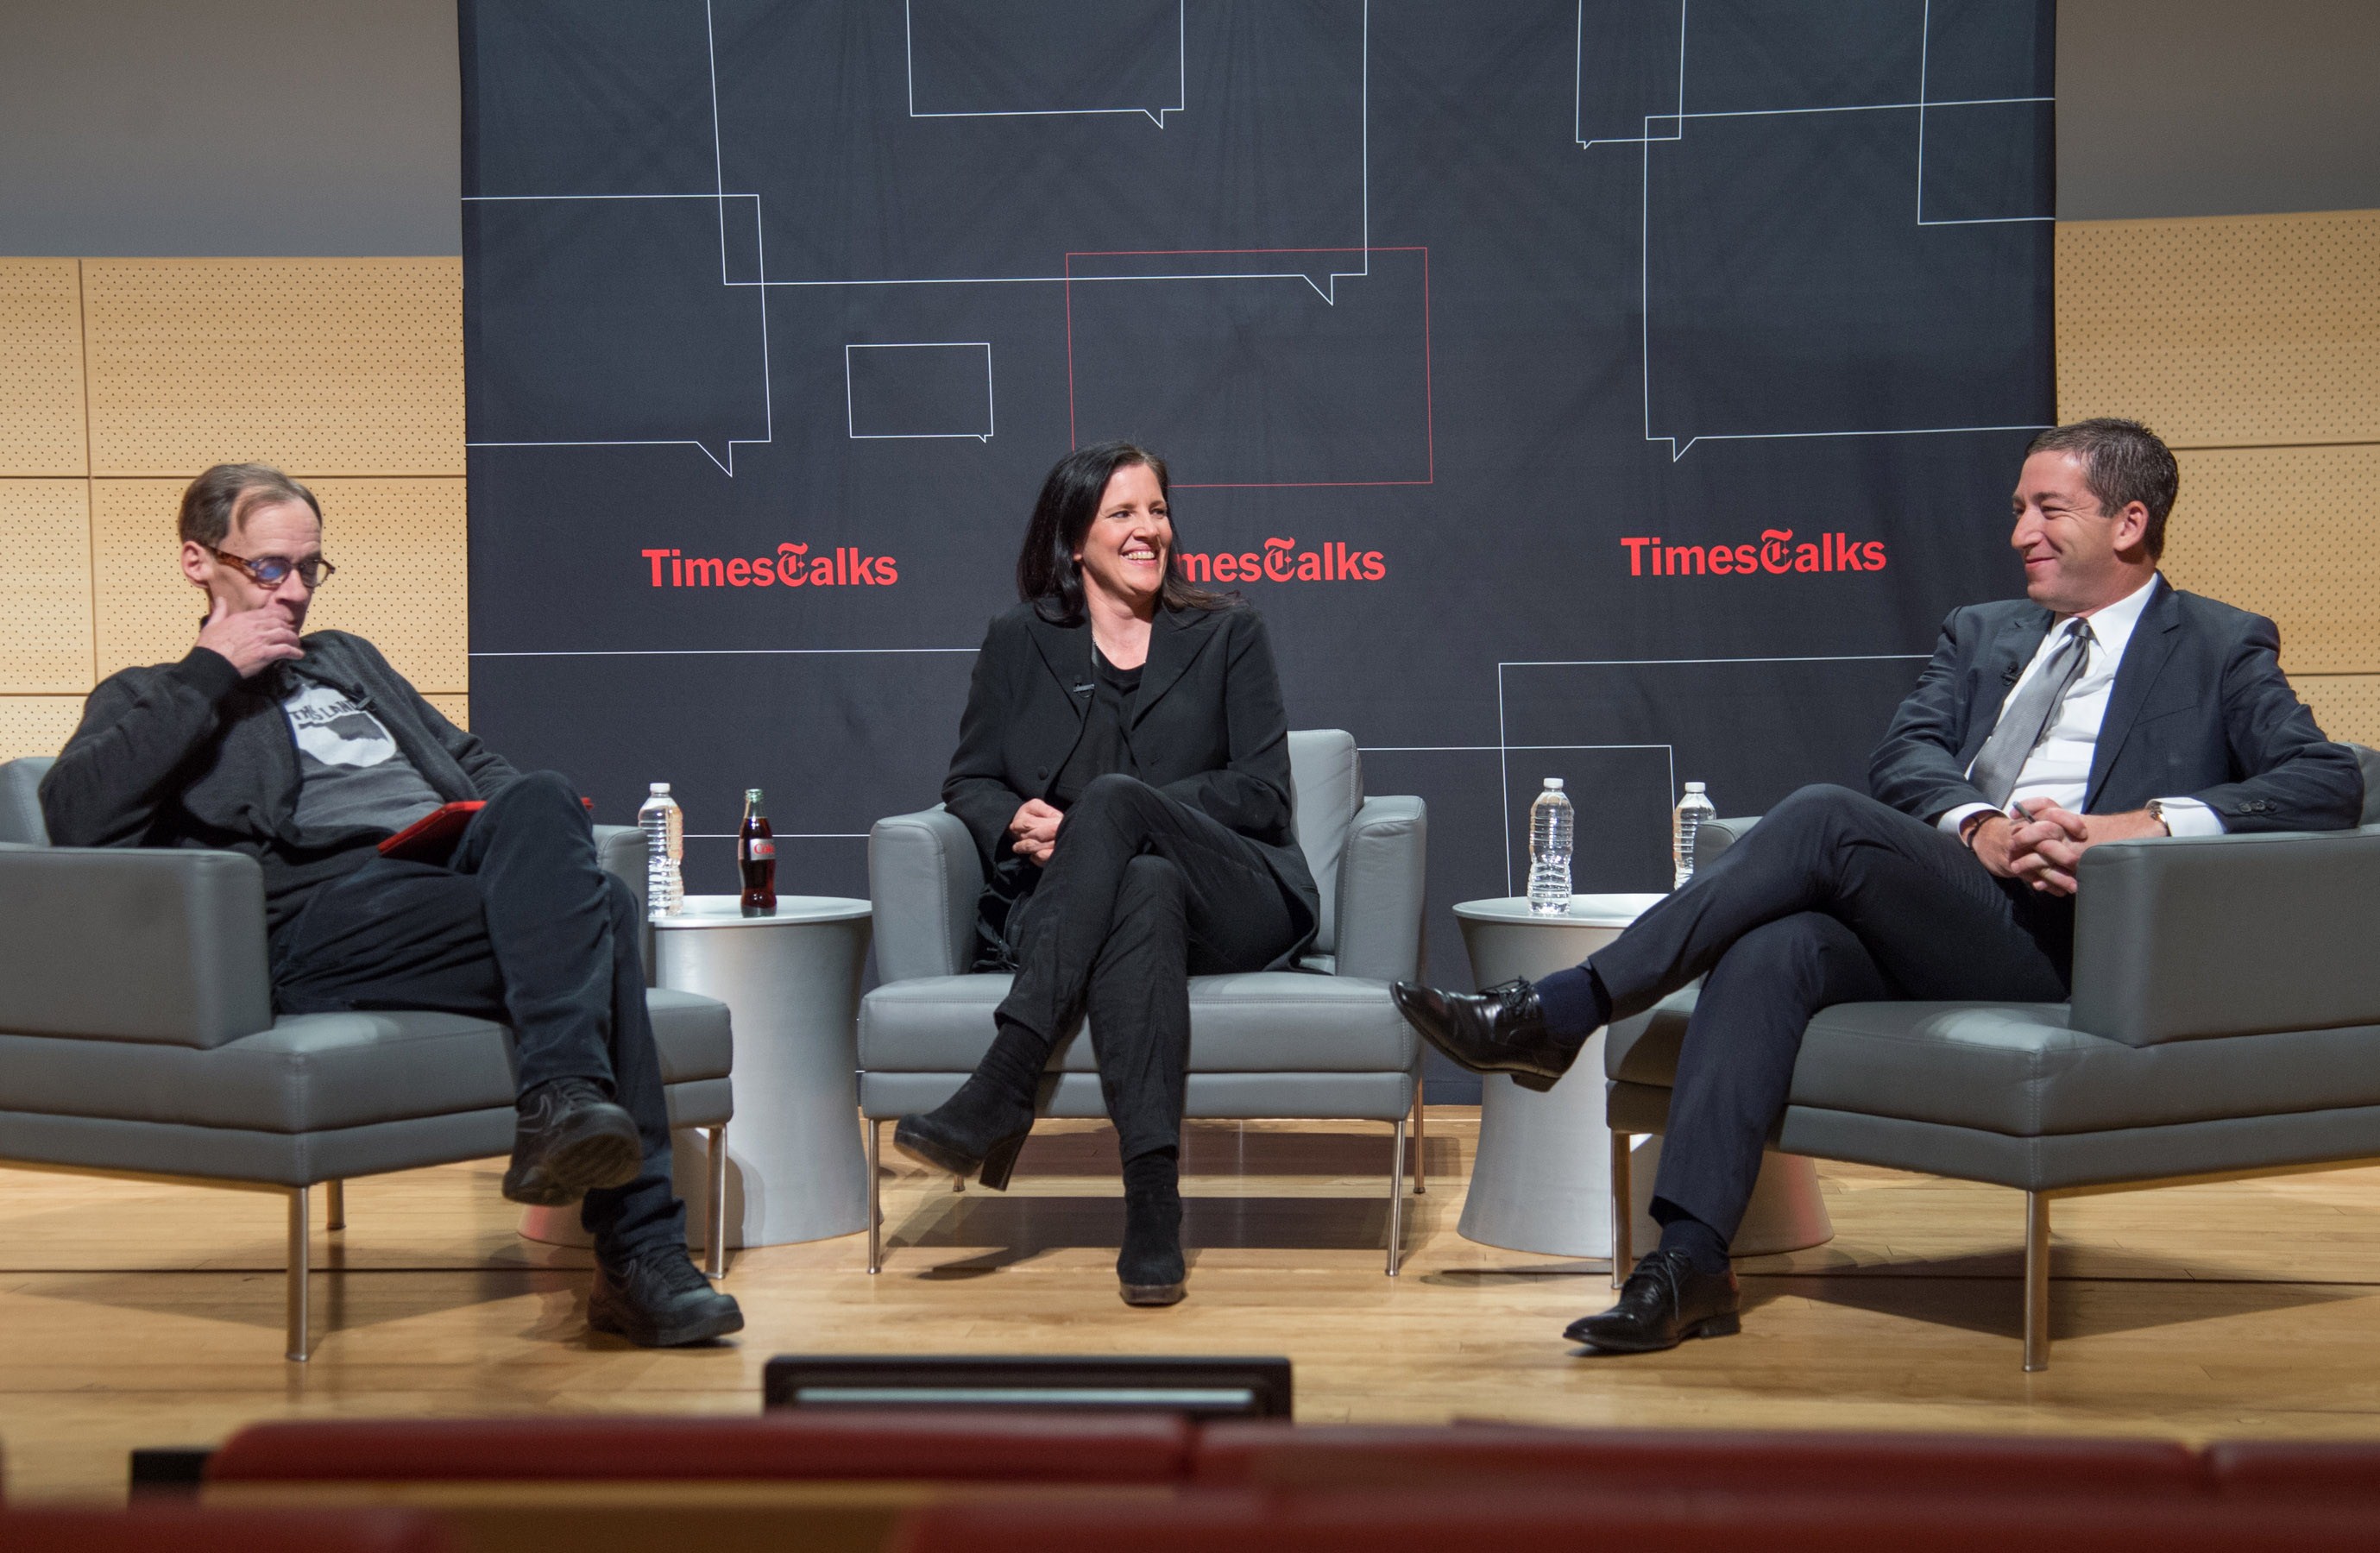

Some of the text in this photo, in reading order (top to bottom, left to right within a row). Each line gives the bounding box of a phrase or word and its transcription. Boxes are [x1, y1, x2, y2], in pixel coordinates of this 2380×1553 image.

[641, 542, 898, 588] TimesTalks
[1174, 537, 1387, 582] mesTalks
[1620, 528, 1887, 576] TimesTalks
